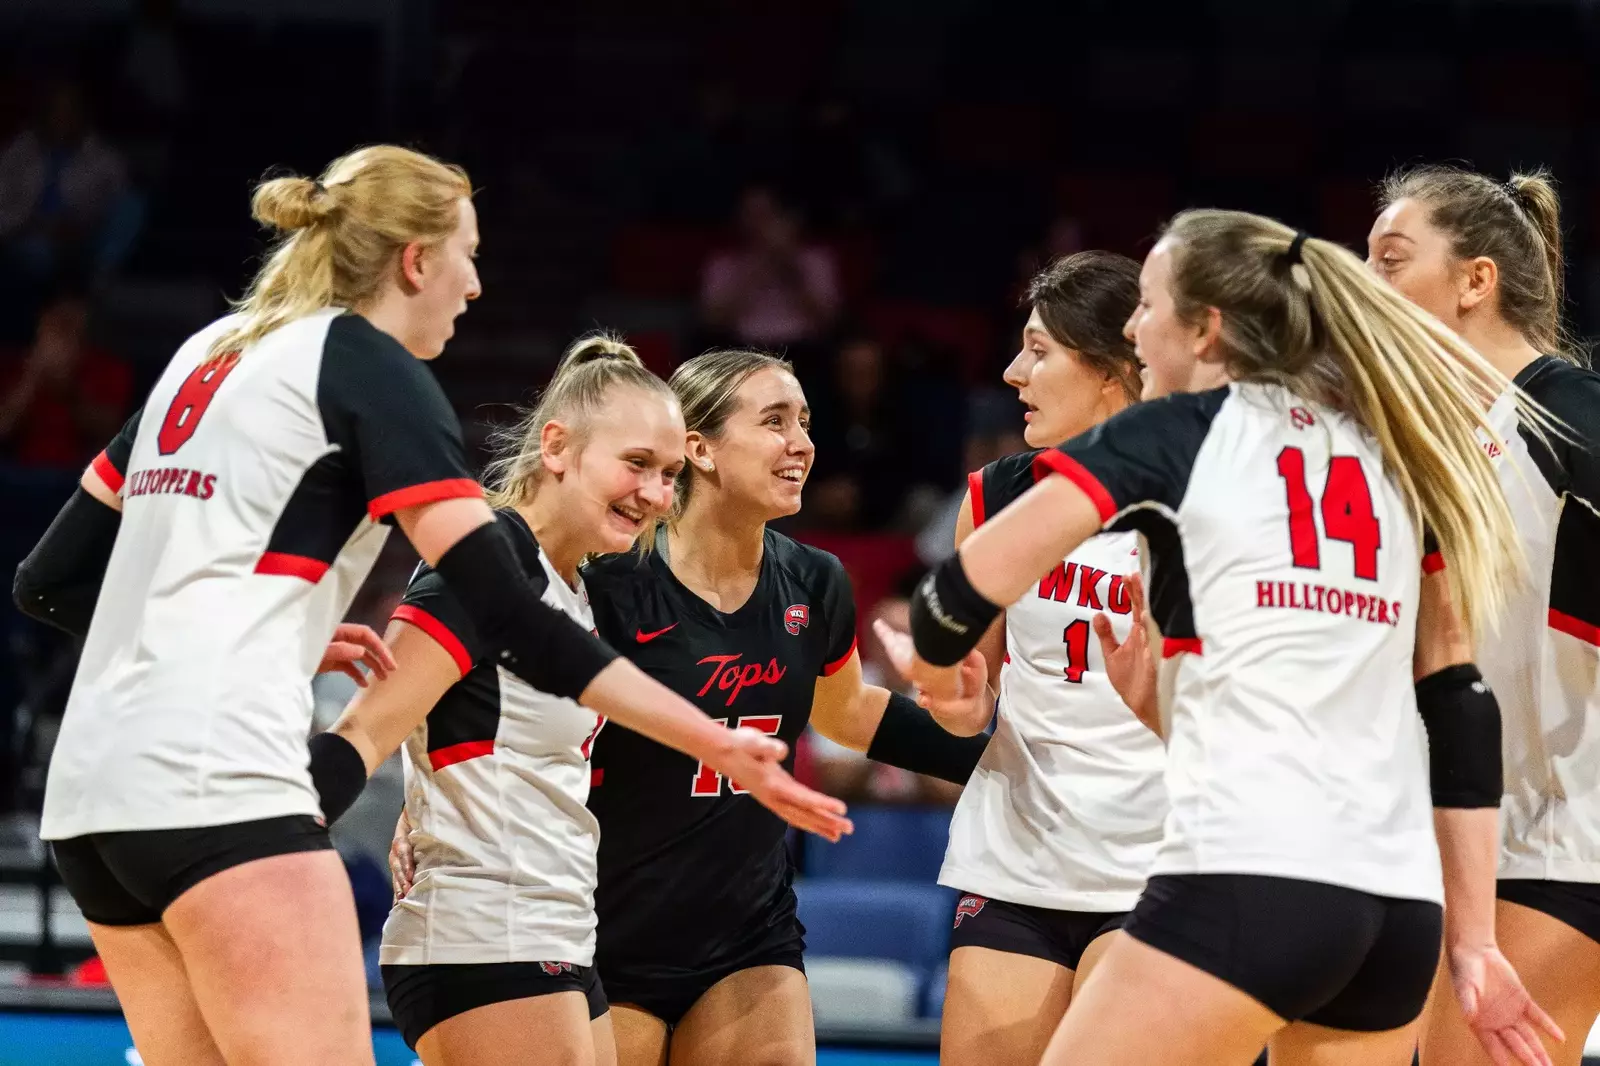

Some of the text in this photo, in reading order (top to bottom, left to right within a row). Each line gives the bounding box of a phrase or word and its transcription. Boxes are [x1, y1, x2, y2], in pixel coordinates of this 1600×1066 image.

[157, 349, 243, 456] 8
[1277, 445, 1381, 581] 14
[1038, 560, 1132, 615] WKU
[1256, 580, 1402, 627] HILLTOPPERS
[696, 652, 786, 706] Tops
[1063, 618, 1090, 684] 1
